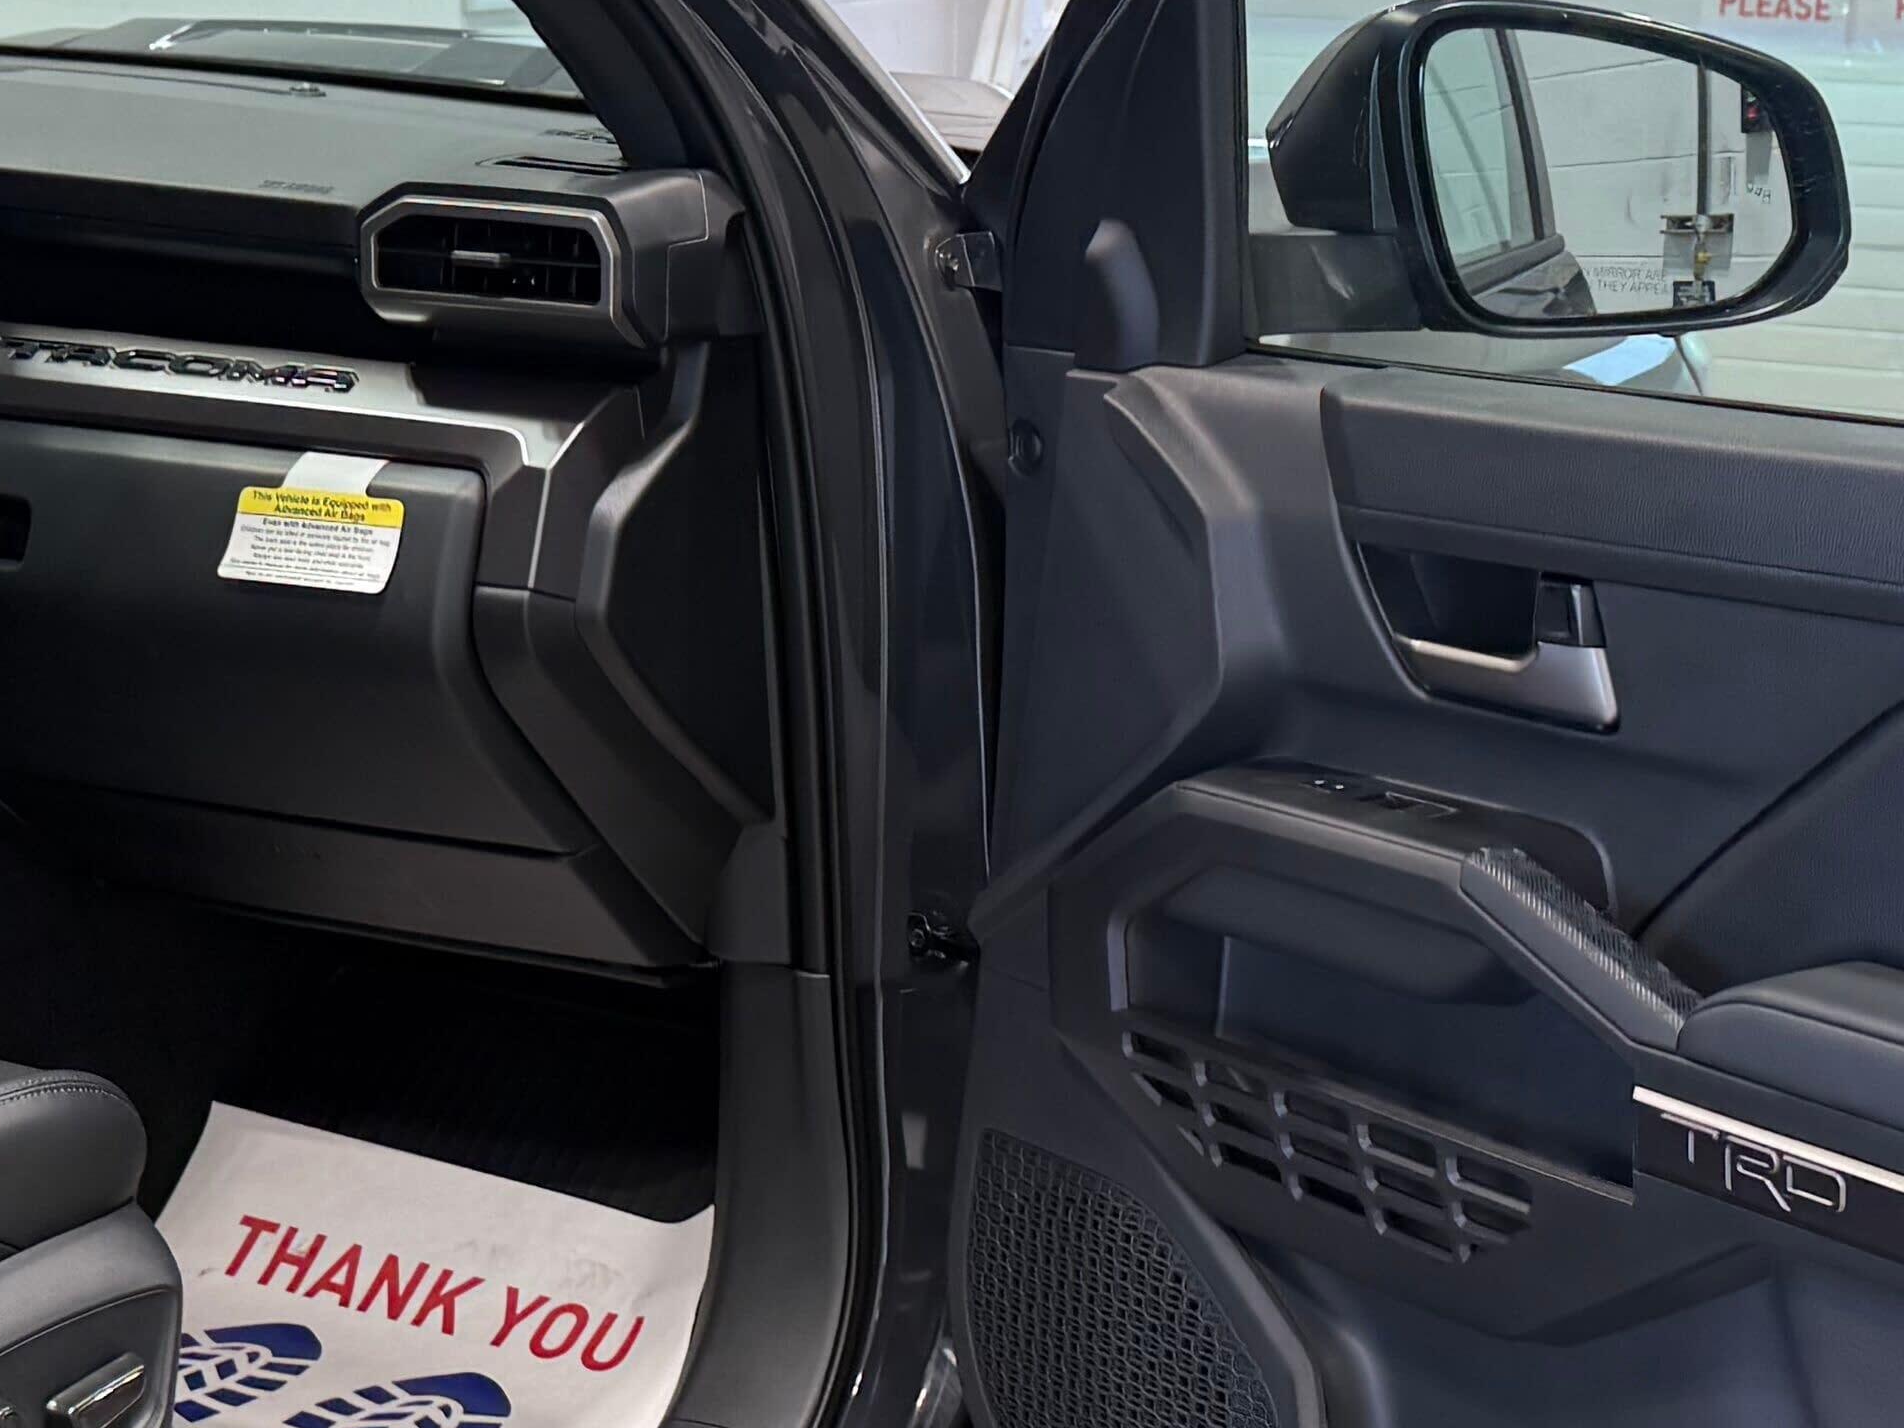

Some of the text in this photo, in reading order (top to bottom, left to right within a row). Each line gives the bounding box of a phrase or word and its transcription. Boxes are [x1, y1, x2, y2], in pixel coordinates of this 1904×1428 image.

[252, 490, 273, 502] This
[276, 492, 309, 506] Vehicle
[322, 497, 369, 513] Equipped
[274, 504, 365, 524] Advanced Air Bags
[1660, 1112, 1847, 1213] TRD
[224, 1214, 645, 1372] THANK YOU
